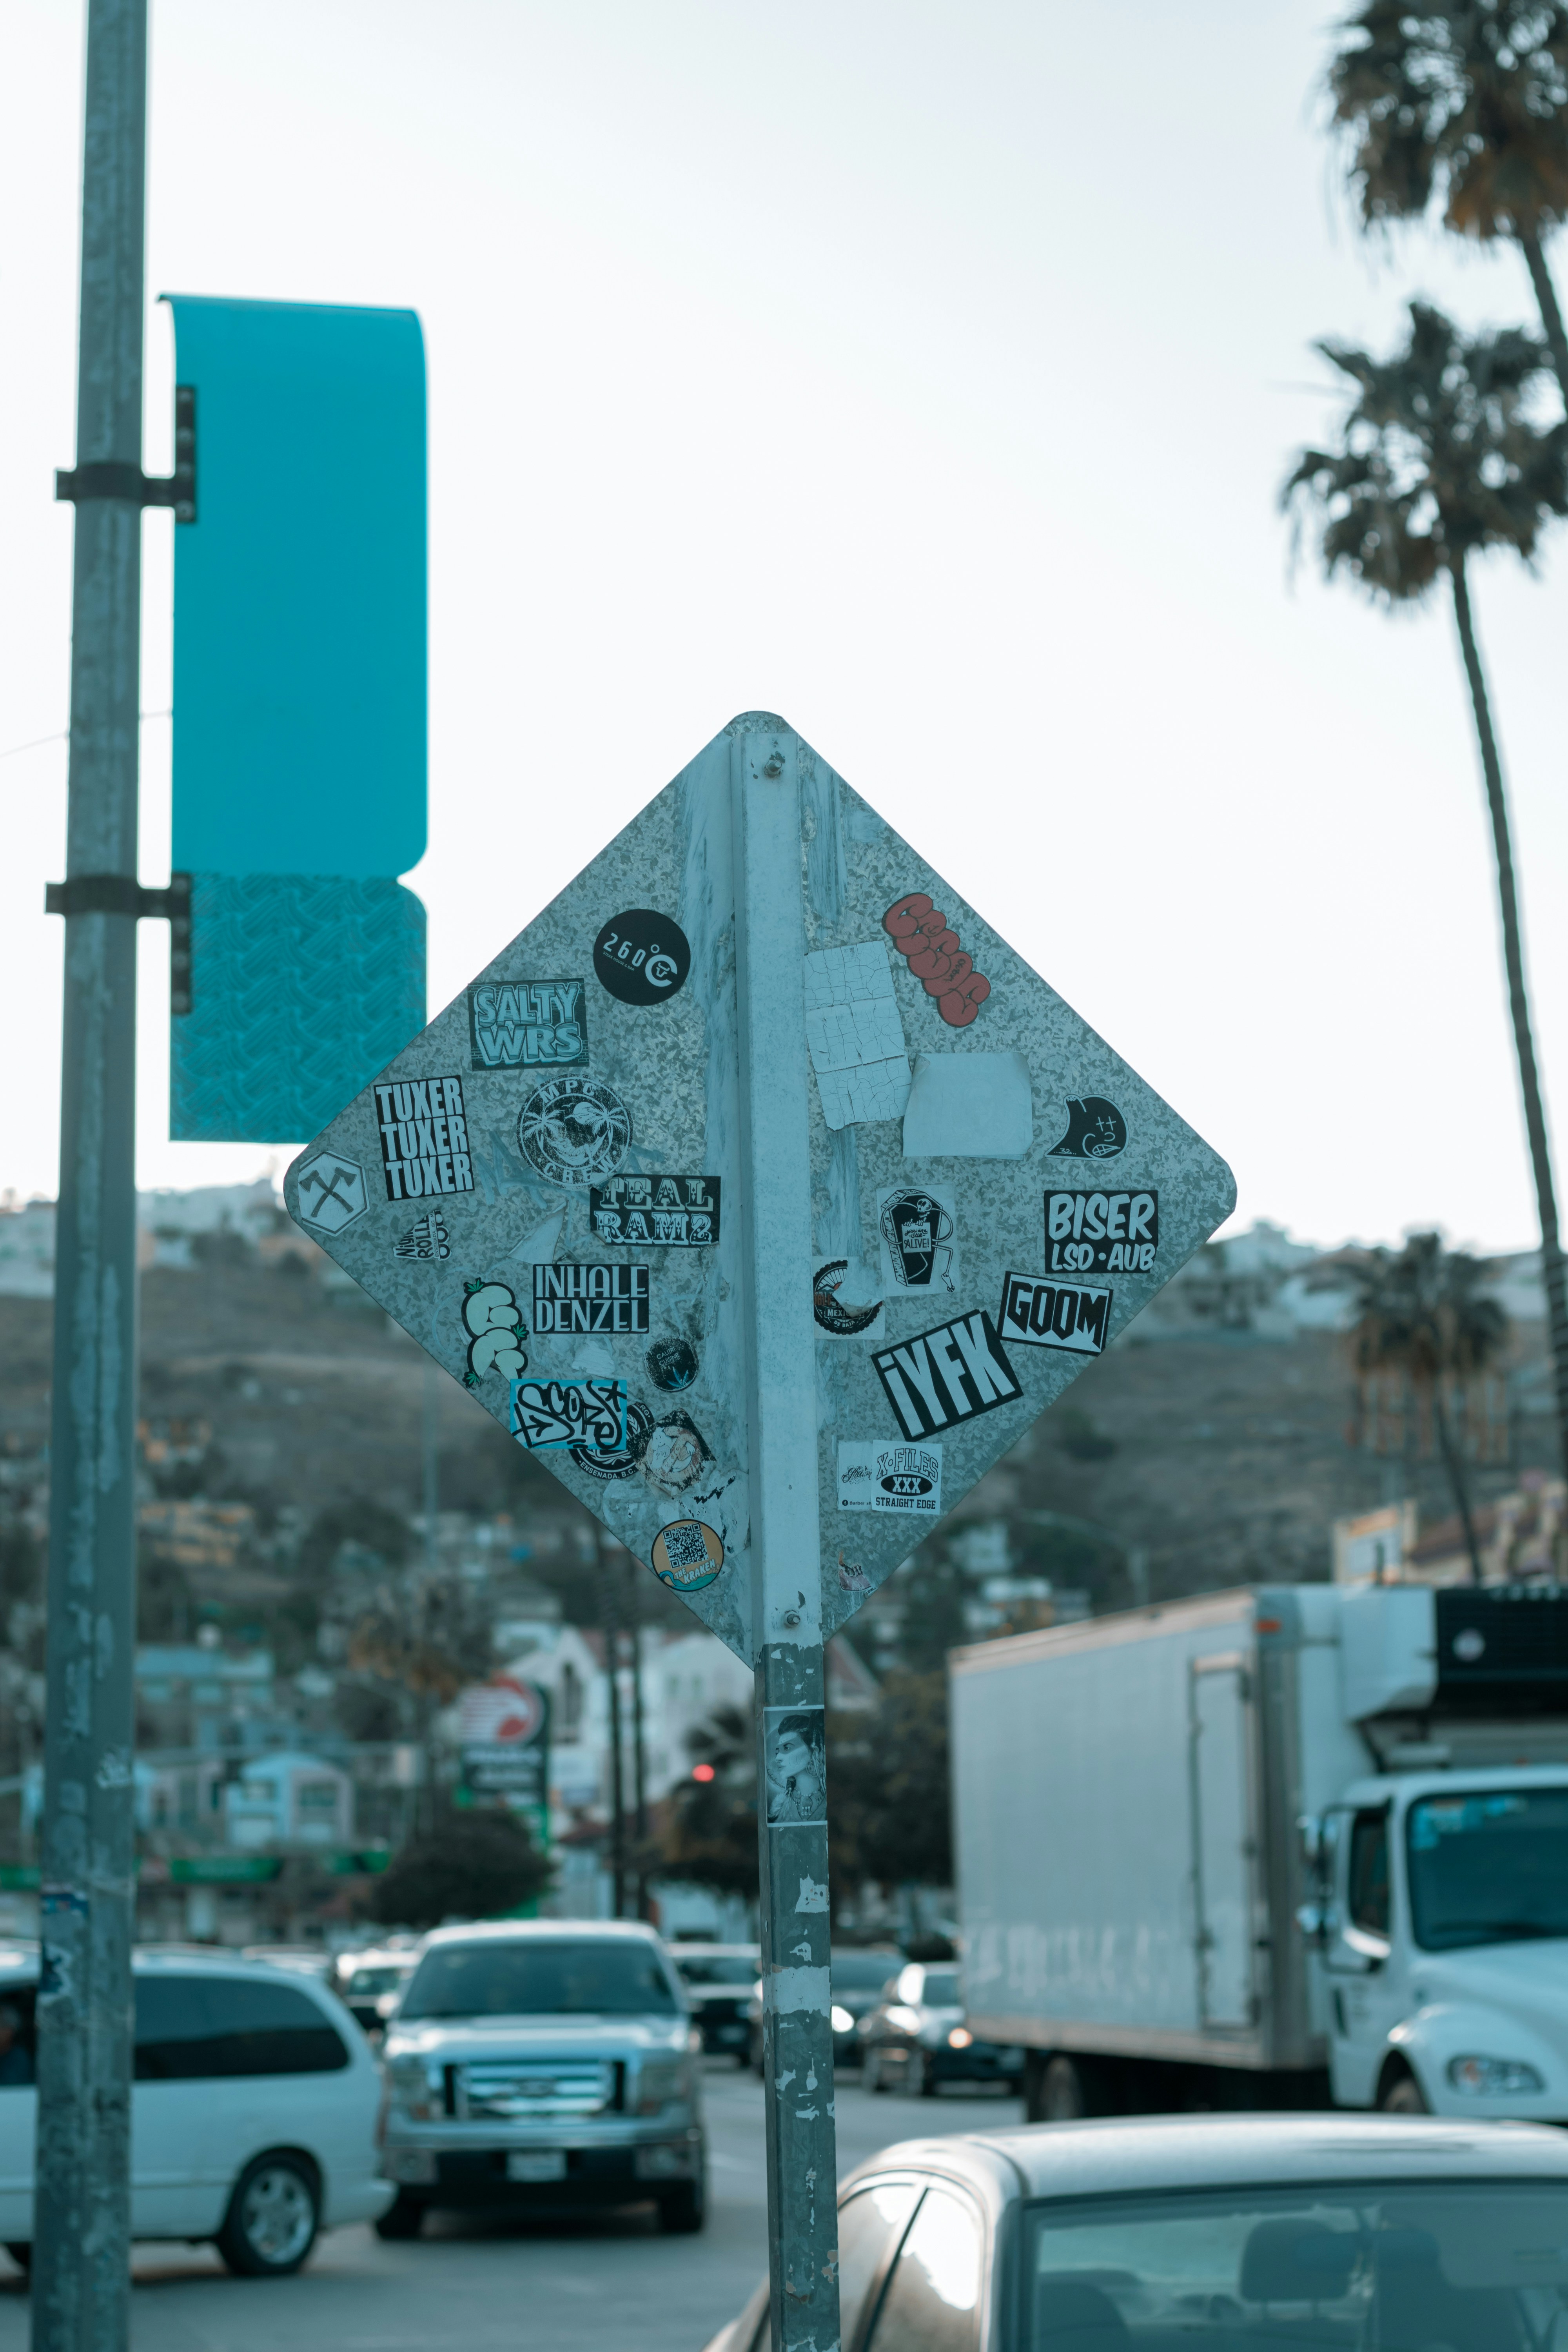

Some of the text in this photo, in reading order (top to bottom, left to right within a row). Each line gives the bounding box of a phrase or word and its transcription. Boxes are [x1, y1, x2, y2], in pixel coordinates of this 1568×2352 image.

[613, 957, 625, 966] HOUSE
[474, 982, 580, 1027] SALTY
[475, 1022, 583, 1066] WRS
[376, 1078, 463, 1123] TUXER
[540, 1080, 597, 1103] MPC
[381, 1115, 468, 1160] TUXER
[386, 1153, 473, 1199] TUXER
[600, 1177, 713, 1211] TEAL
[1049, 1193, 1155, 1241] BISER
[904, 1238, 929, 1249] ALIVE!
[536, 1266, 648, 1298] INHALE
[536, 1299, 648, 1332] DENZEL
[1007, 1280, 1108, 1349] GOOM
[621, 1468, 636, 1477] B.C.
[892, 1476, 921, 1494] XXX
[876, 1497, 936, 1509] STRAIGHT EDGE
[675, 1568, 686, 1579] THE
[684, 1559, 715, 1583] KRAKEN
